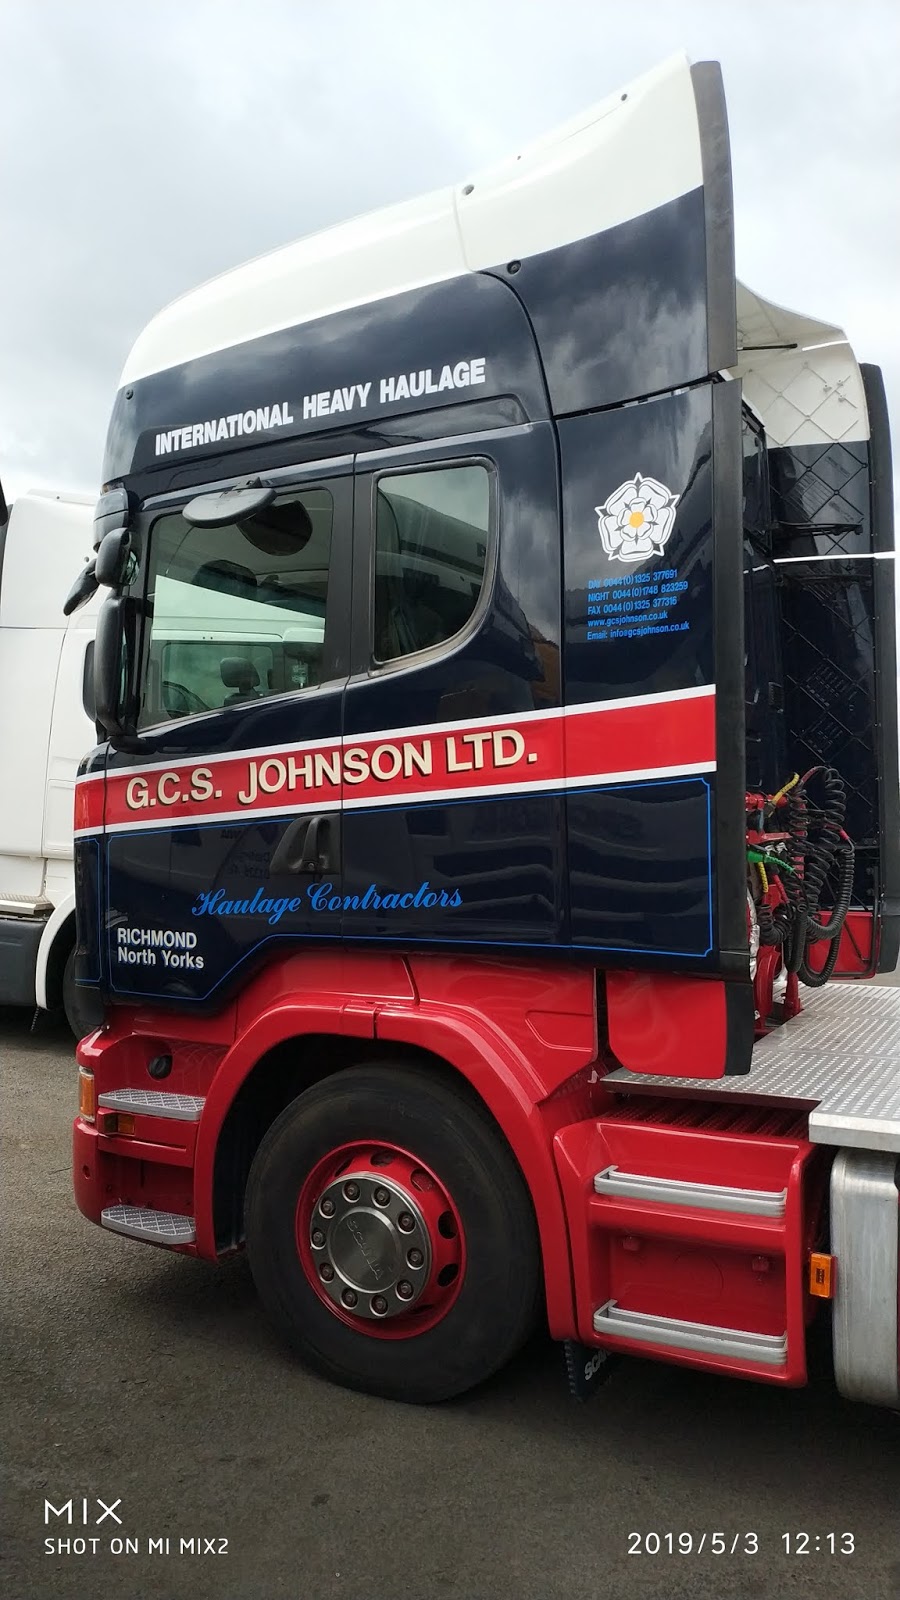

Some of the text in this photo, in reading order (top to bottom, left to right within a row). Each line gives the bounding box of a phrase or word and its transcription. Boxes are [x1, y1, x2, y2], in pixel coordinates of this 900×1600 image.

[155, 357, 486, 455] INTERNATIONAL HEAVY HAULAGE
[588, 579, 601, 589] DAY
[652, 569, 678, 581] 377691
[588, 591, 609, 602] NIGHT
[660, 581, 688, 593] 823259
[587, 605, 601, 615] FAX
[652, 596, 677, 608] 377316
[587, 610, 668, 627] www.gcsjohnson.co.uk
[587, 621, 690, 640] Email: info@gcsjohnson.co.uk
[126, 729, 538, 810] G.C.S. JOHNSON LTD.
[191, 880, 464, 925] Haulage Contractors
[117, 927, 198, 951] RICHMOND
[117, 945, 205, 970] North Yorks
